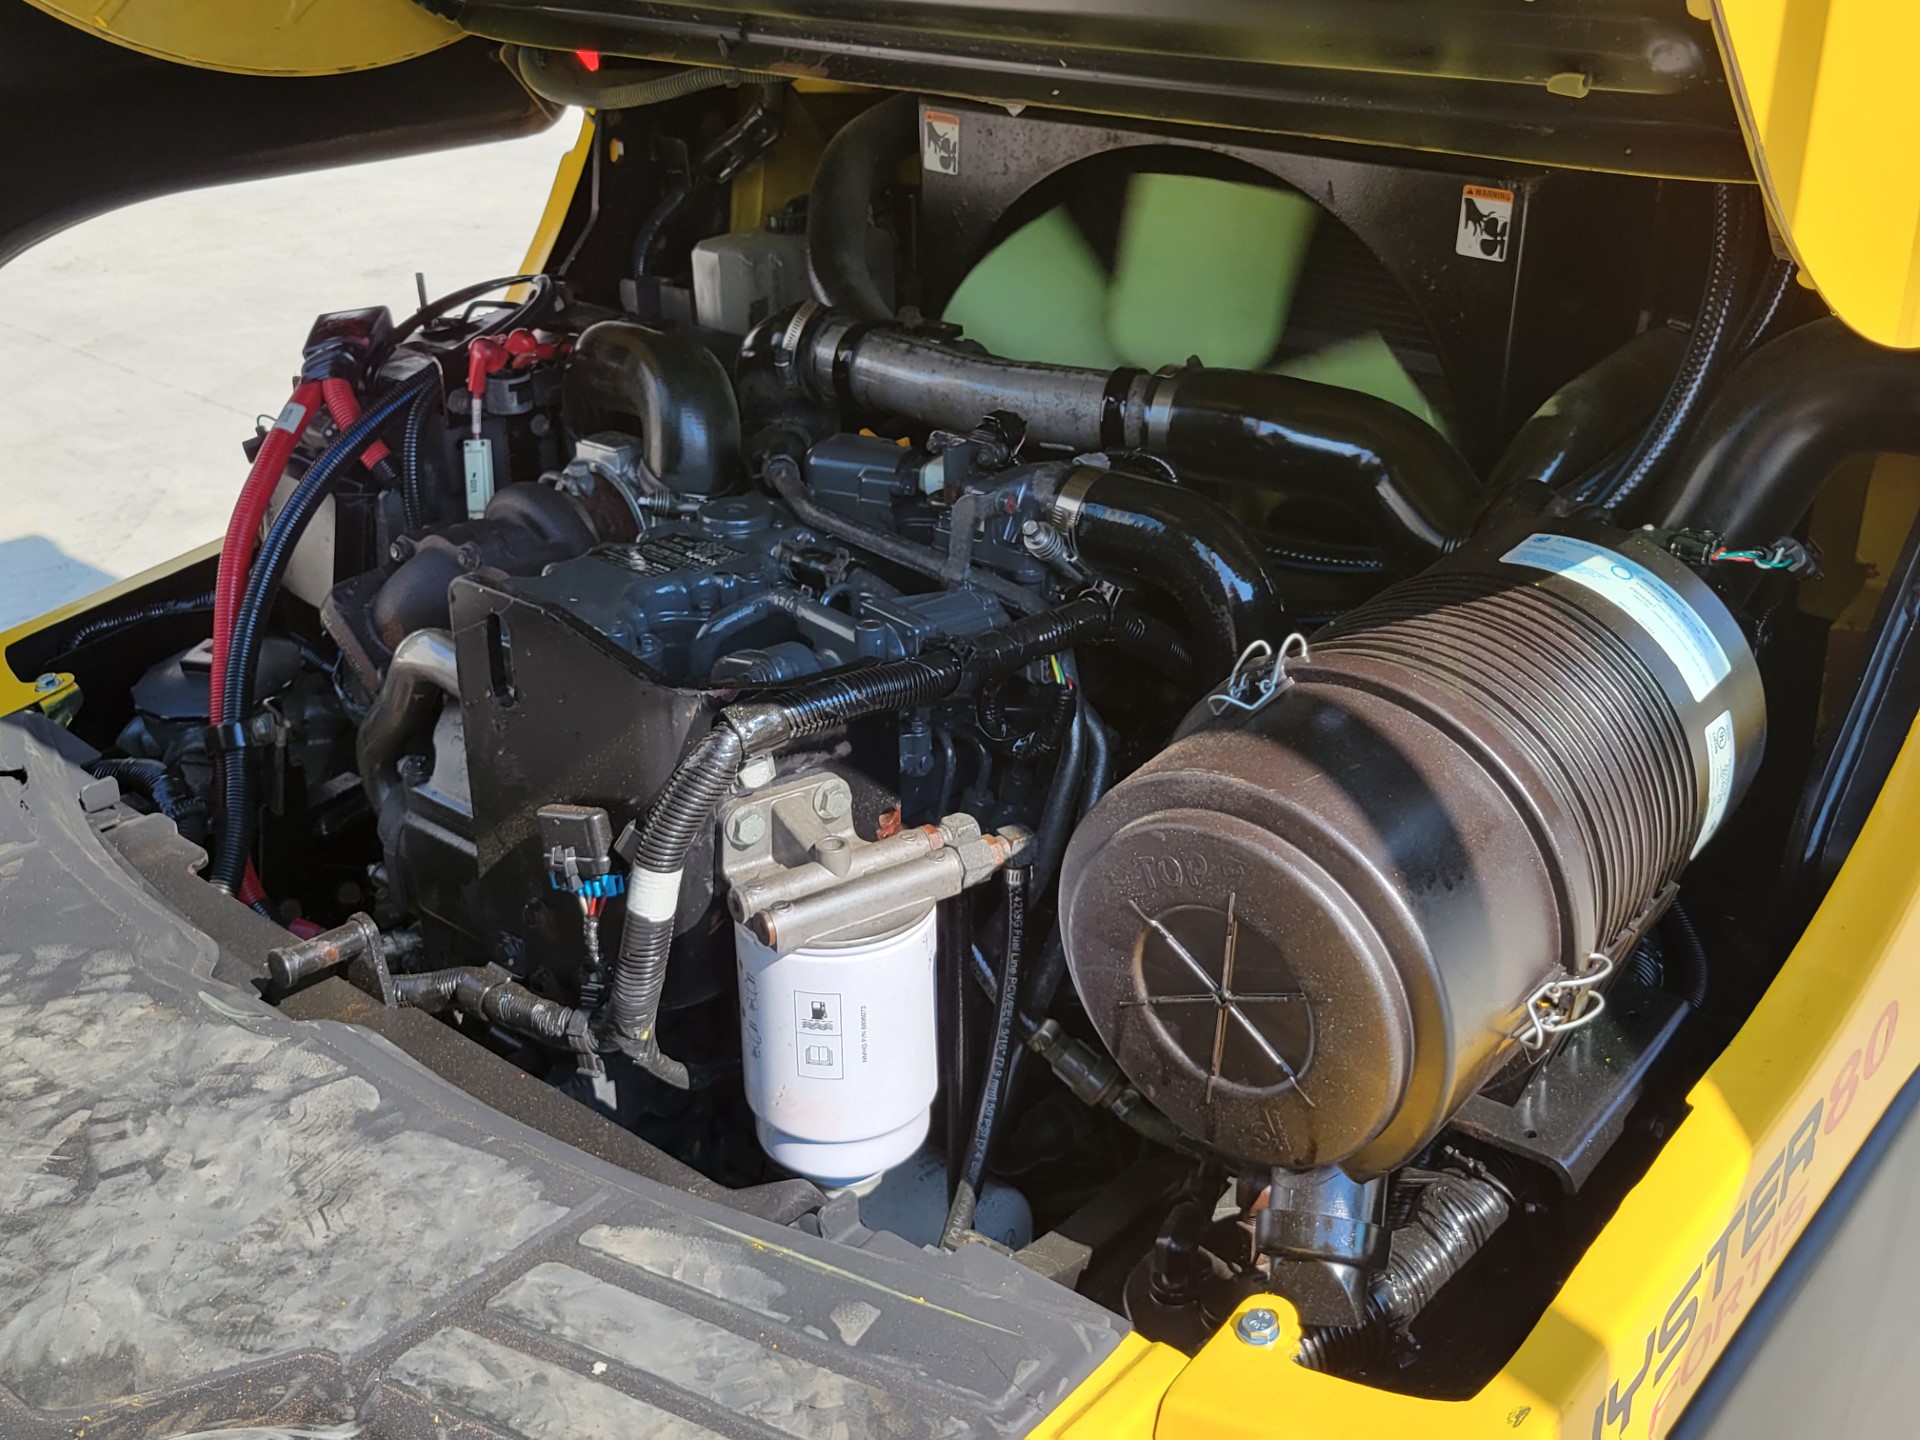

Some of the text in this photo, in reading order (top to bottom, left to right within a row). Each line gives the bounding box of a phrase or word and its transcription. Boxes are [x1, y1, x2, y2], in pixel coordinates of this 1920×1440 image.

[1474, 188, 1511, 202] WARNING
[1133, 852, 1208, 891] TOP
[1011, 929, 1022, 952] Fuel
[1008, 952, 1020, 974] Line
[1824, 1000, 1899, 1136] 80
[985, 1102, 996, 1116] 50
[980, 1117, 992, 1138] PSI
